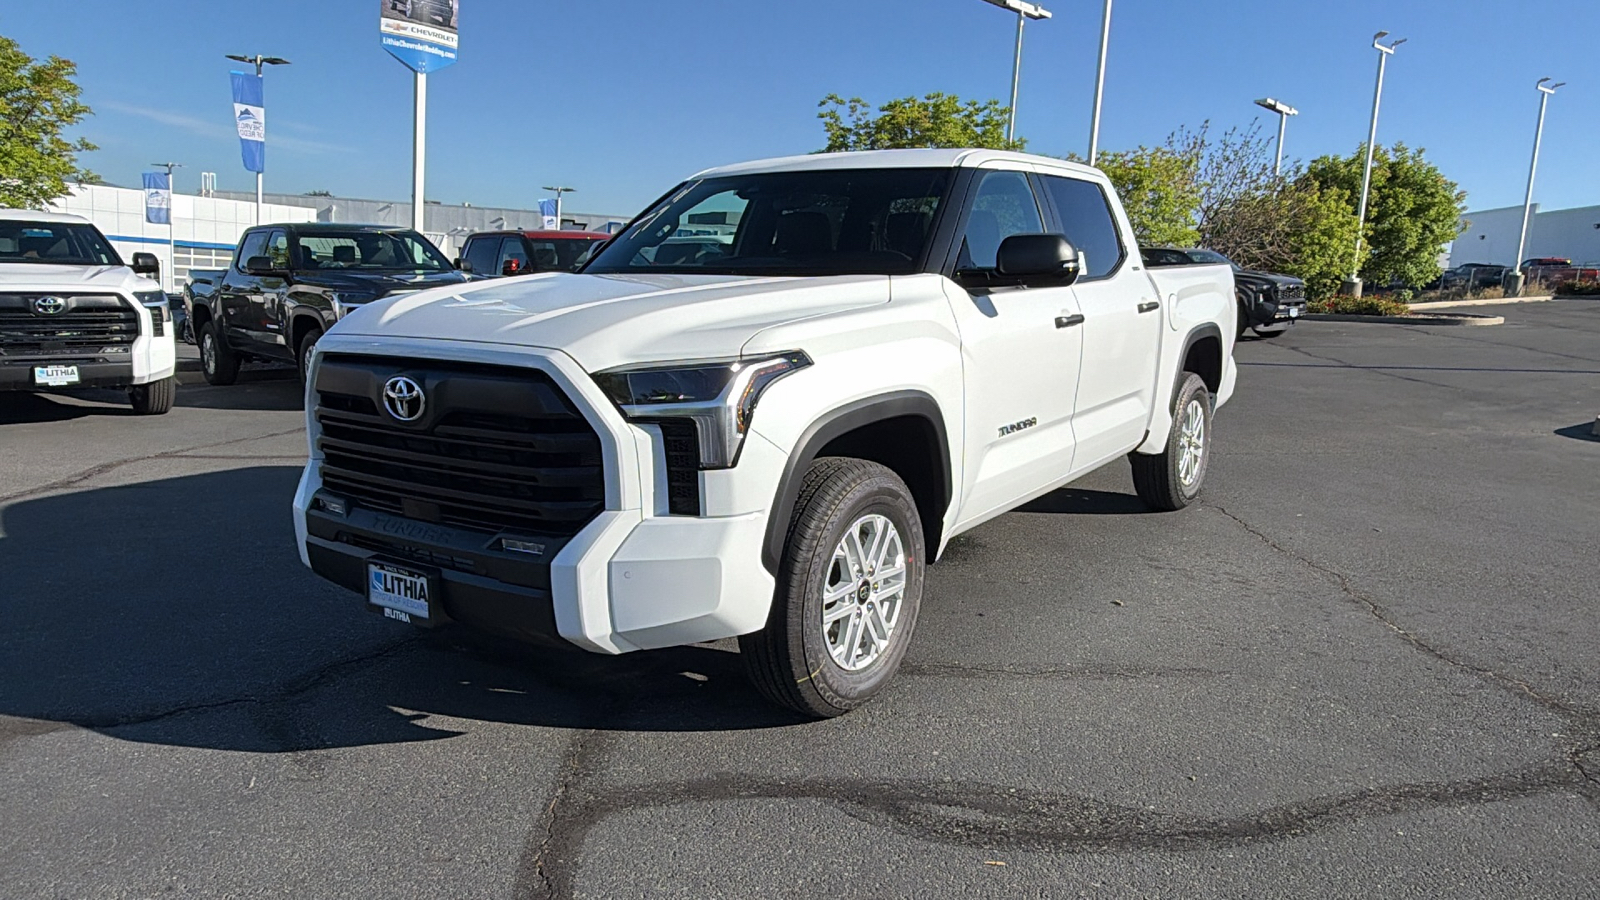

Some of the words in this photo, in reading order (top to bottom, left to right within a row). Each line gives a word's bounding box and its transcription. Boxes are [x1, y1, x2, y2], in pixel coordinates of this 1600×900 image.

[411, 26, 455, 43] CHEVROLET
[46, 368, 76, 377] LITHIA
[997, 416, 1037, 438] TUNDRA
[383, 572, 428, 602] LITHIA
[391, 609, 411, 623] LITHIA
